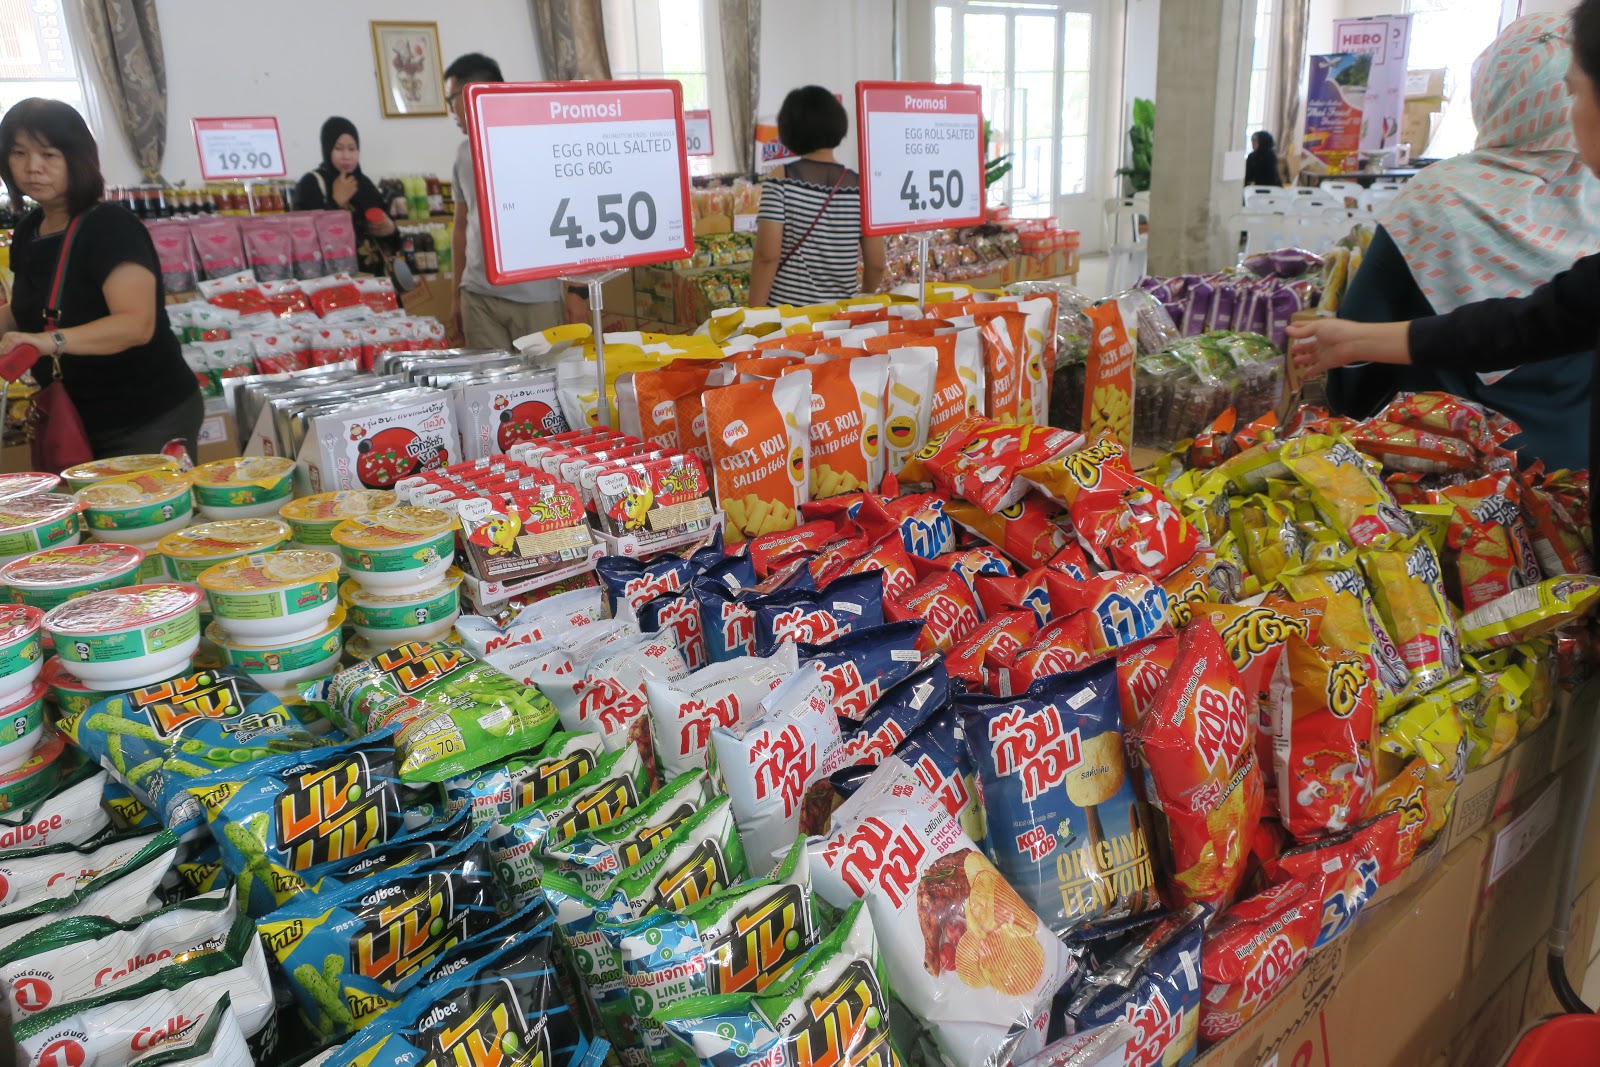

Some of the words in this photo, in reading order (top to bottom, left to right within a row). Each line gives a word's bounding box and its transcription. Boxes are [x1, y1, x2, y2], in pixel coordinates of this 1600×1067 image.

[1343, 34, 1382, 46] HERO
[550, 99, 622, 119] Promosi
[905, 95, 947, 110] Promosi
[905, 128, 922, 139] EGG
[925, 128, 945, 139] ROLL
[946, 128, 975, 140] SALTED
[553, 143, 582, 158] EGG
[587, 141, 620, 157] ROLL
[624, 138, 672, 154] SALTED
[905, 143, 922, 155] EGG
[925, 143, 940, 155] 60G
[219, 152, 272, 170] 19.90
[554, 162, 584, 178] EGG
[588, 161, 613, 175] 60G
[900, 169, 964, 211] 4.50
[502, 203, 515, 211] RM
[550, 191, 657, 249] 4.50
[945, 383, 964, 402] ROLL
[950, 400, 964, 418] EGGS
[835, 410, 860, 433] ROLL
[841, 429, 859, 448] EGGS
[720, 447, 760, 471] CREPE
[760, 433, 786, 459] ROLL
[733, 469, 767, 489] SALTED
[768, 454, 786, 475] EGGS
[644, 645, 659, 658] KOB
[653, 645, 668, 659] KOB
[1197, 688, 1229, 771] KOB
[1222, 690, 1247, 768] KOB
[437, 739, 454, 756] 70
[823, 761, 837, 776] BBQ
[365, 780, 388, 798] BUNBUN
[472, 806, 494, 820] LINE
[0, 815, 62, 849] albee
[937, 835, 955, 854] BBQ
[1017, 826, 1045, 852] KOB
[1031, 836, 1056, 861] KOB
[348, 854, 386, 875] Calbee
[629, 848, 668, 880] Calbee
[360, 885, 402, 907] Calbee
[1237, 938, 1257, 960] Ridged
[1281, 907, 1299, 927] Chips
[1243, 937, 1292, 1003] KOB
[21, 983, 43, 1007] 1
[655, 981, 687, 1000] LINE
[419, 1002, 458, 1033] Calbee
[131, 1013, 205, 1051] Calb
[524, 1013, 548, 1044] BUNBUN
